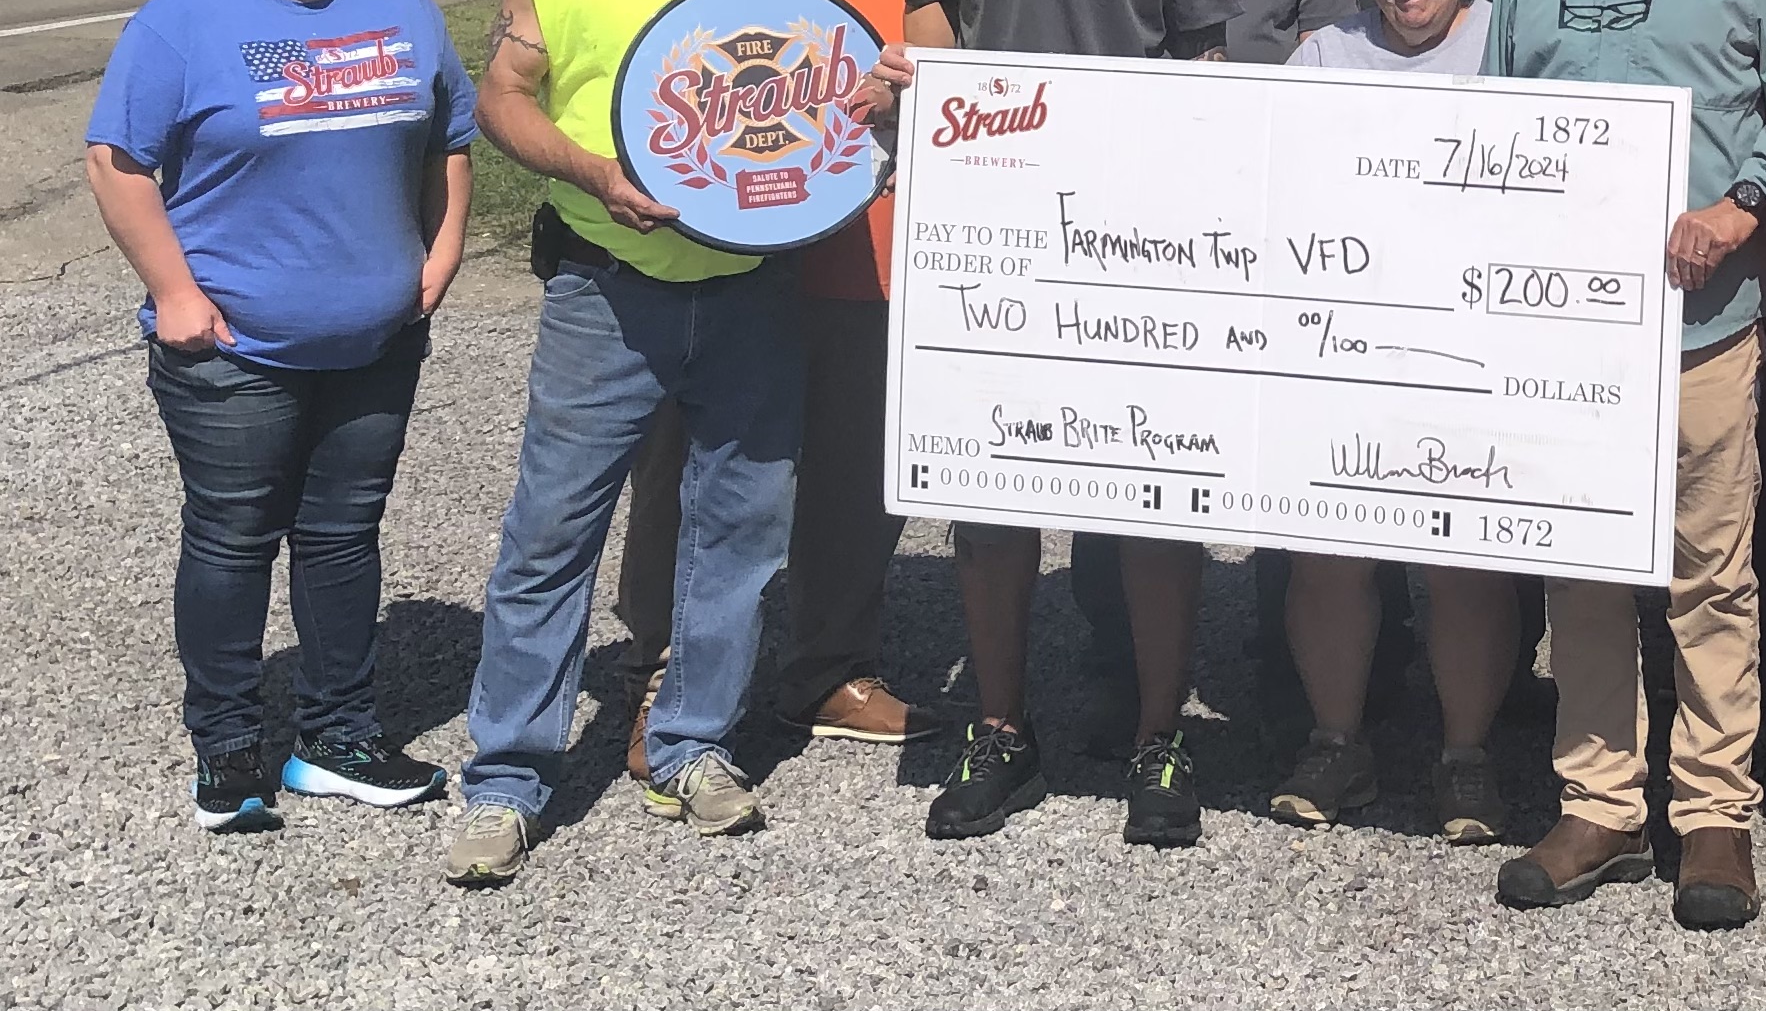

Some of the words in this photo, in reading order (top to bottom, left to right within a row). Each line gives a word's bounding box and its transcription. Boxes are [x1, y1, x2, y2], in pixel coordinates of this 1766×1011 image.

[736, 39, 773, 56] FIRE
[283, 38, 399, 106] Straub
[327, 95, 386, 111] BREWERY
[647, 23, 859, 157] Straub
[931, 81, 1047, 148] Straub
[745, 130, 789, 149] DEPT.
[1534, 116, 1610, 146] 1872
[964, 155, 1026, 168] BREWERY
[1355, 156, 1421, 179] DATE
[1434, 128, 1568, 194] 7/16/2024
[746, 180, 797, 194] PENNSYLVANIA
[752, 172, 779, 183] SALUTE
[779, 171, 789, 180] TO
[748, 190, 797, 204] FIREFIGHTERS
[914, 221, 957, 243] PAY
[962, 224, 993, 245] TO
[1000, 227, 1048, 250] THE
[913, 250, 993, 275] ORDER
[1000, 256, 1032, 277] OF
[1287, 232, 1370, 275] VFD
[938, 283, 1027, 332] TWO
[1056, 299, 1199, 351] HUNDRED
[1502, 376, 1622, 405] DOLLARS
[907, 433, 981, 458] MEMO
[1477, 514, 1553, 548] 1872
